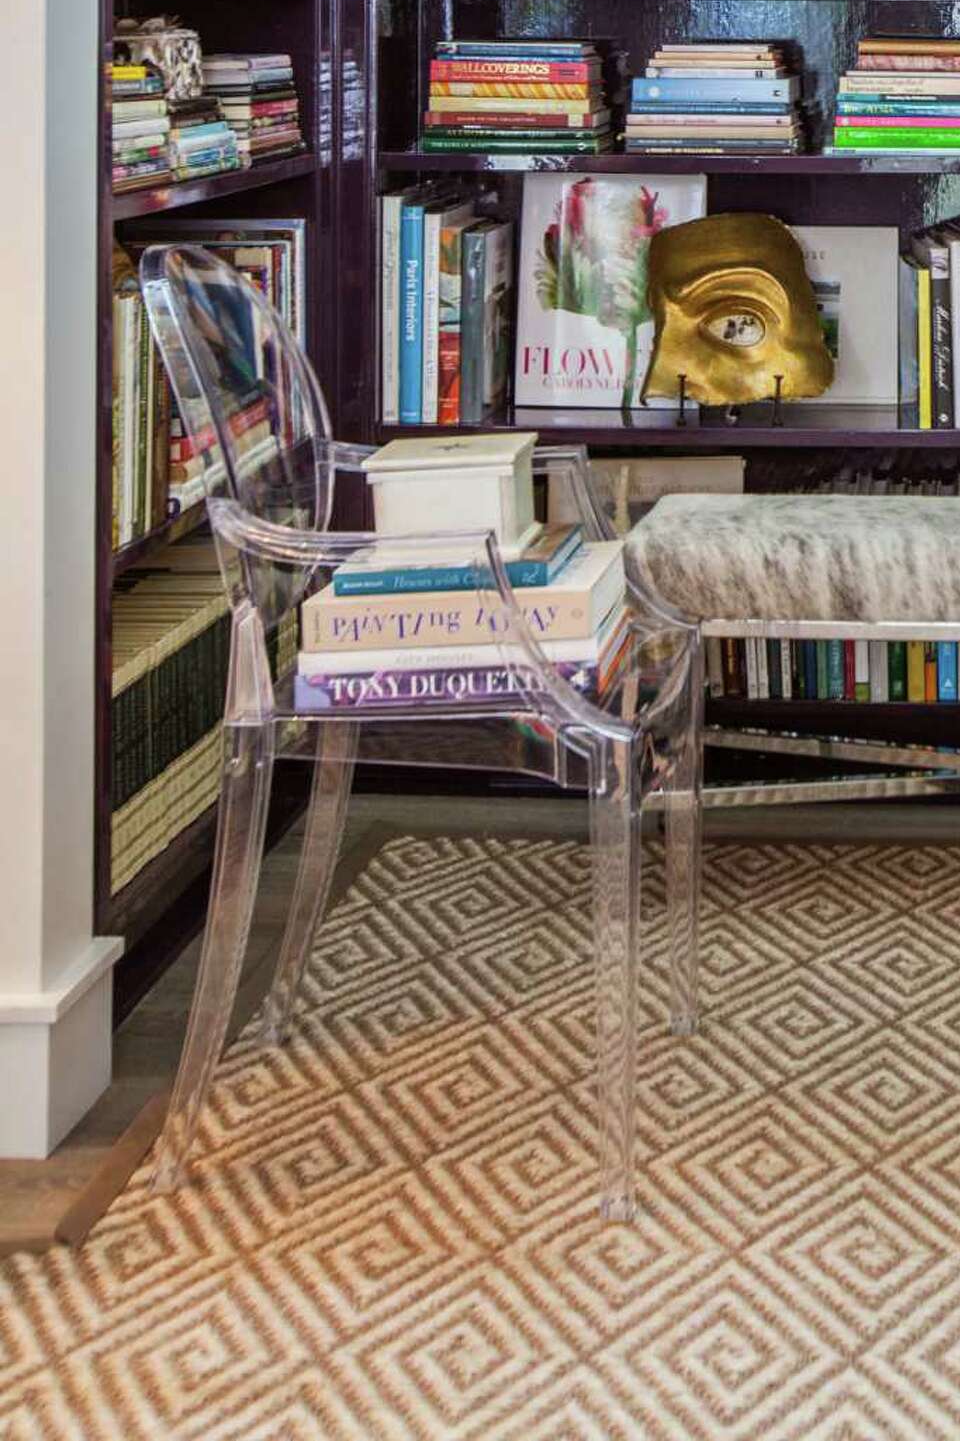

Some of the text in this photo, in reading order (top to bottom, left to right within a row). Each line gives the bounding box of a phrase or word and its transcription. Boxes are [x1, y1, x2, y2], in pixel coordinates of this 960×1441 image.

[405, 259, 419, 341] Paris Interiors
[329, 674, 406, 701] TONY
